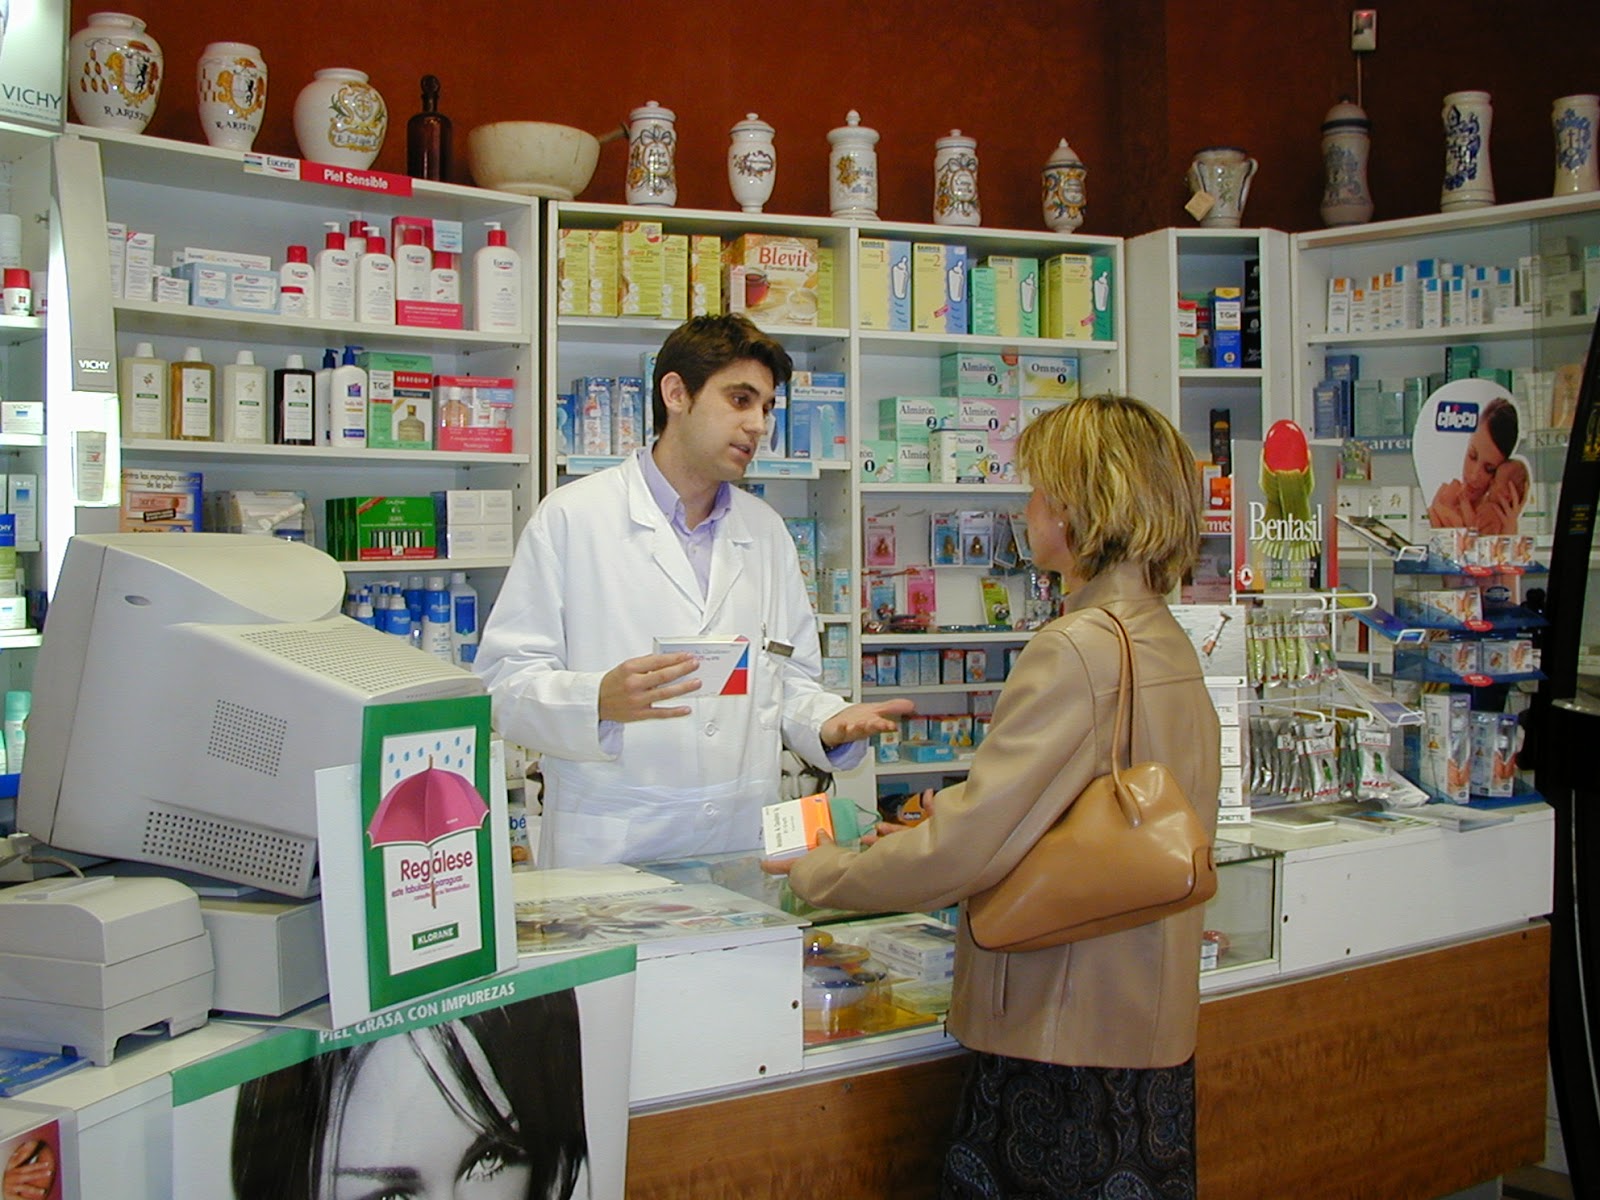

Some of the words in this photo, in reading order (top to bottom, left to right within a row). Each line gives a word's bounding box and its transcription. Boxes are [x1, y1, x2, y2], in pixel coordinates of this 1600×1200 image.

[2, 84, 61, 109] VICHY
[266, 157, 296, 169] Eucerin
[324, 169, 344, 183] Piel
[345, 172, 388, 190] Sensible
[759, 246, 809, 268] Blevit
[933, 254, 941, 267] 2
[1080, 265, 1088, 277] 2
[78, 360, 110, 370] VICHY
[960, 362, 996, 372] Almirón
[899, 405, 935, 415] Almirón
[961, 405, 997, 415] Almirón
[1437, 405, 1477, 429] chicco
[1535, 433, 1567, 447] KLO
[1249, 502, 1322, 542] Bentasil
[401, 850, 473, 882] Regálese
[417, 927, 454, 945] KLORANE
[319, 1024, 351, 1044] PIEL
[354, 1012, 404, 1034] GRASA
[408, 1003, 438, 1022] CON
[441, 981, 516, 1014] IMPUREZAS
